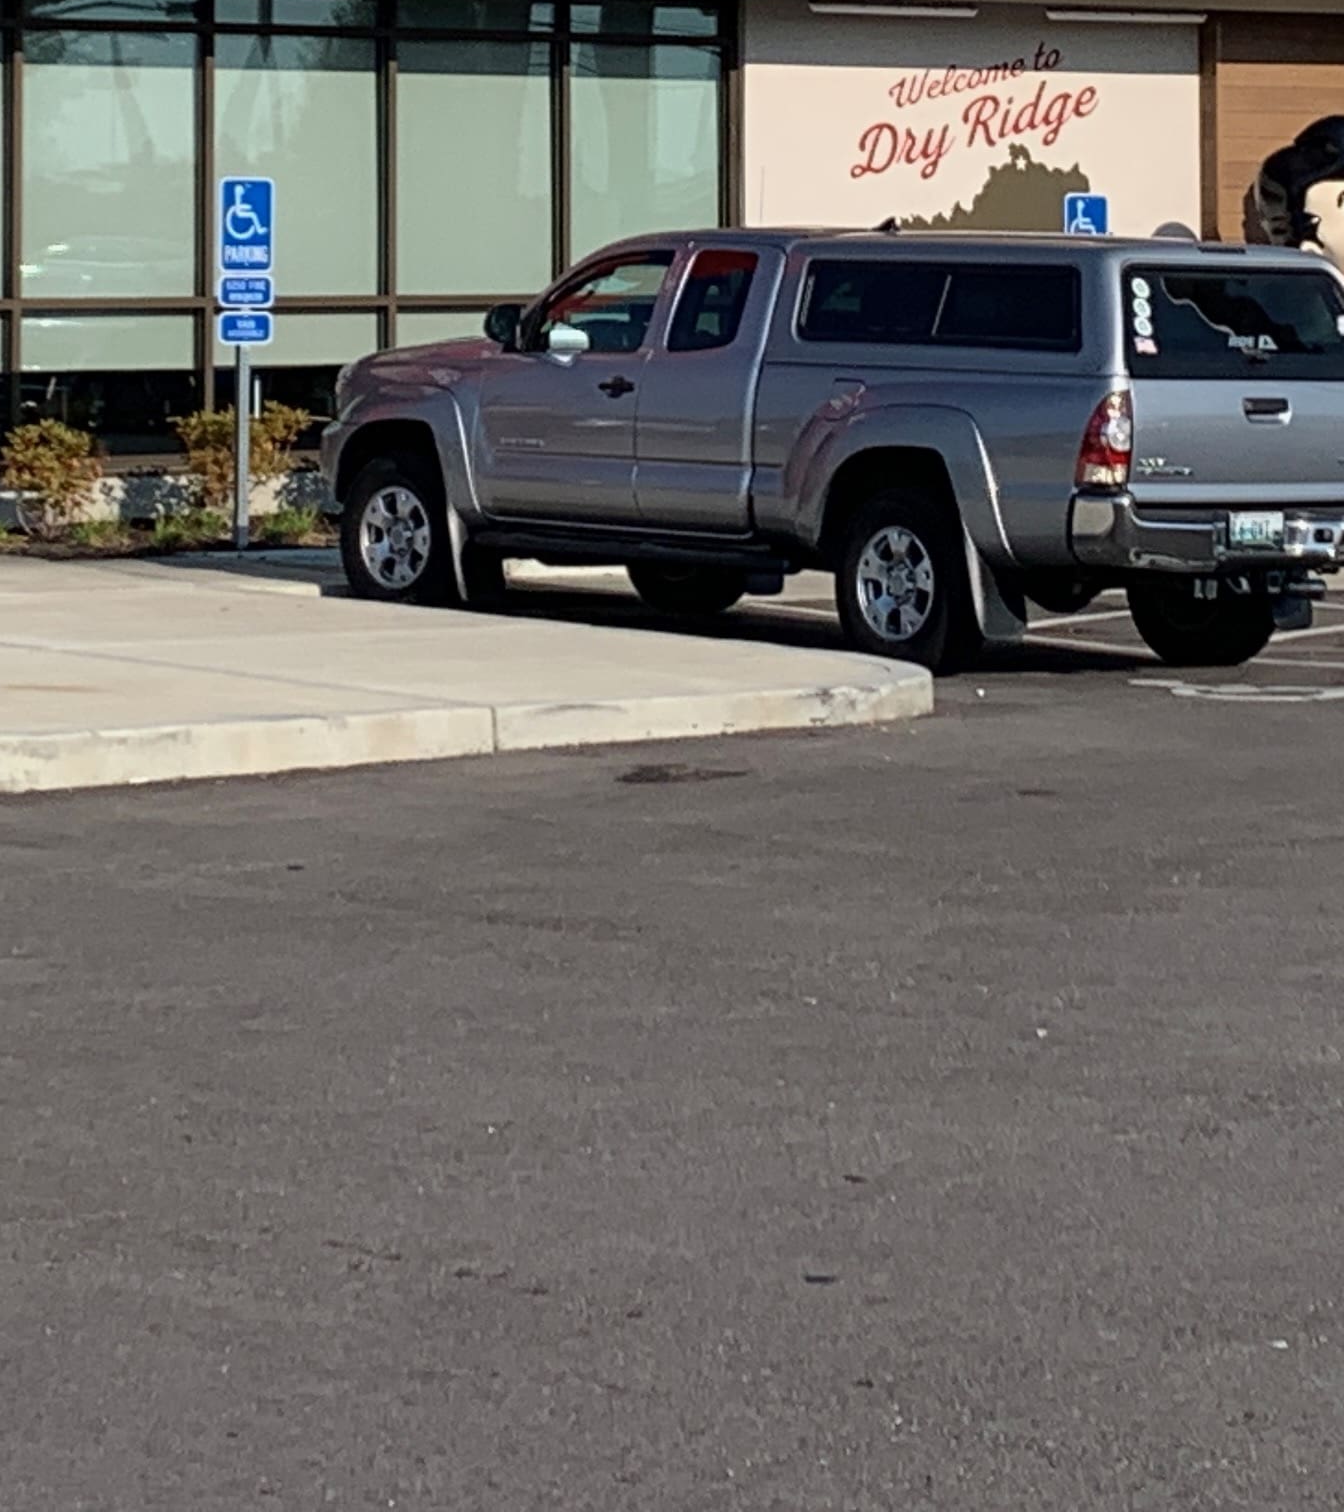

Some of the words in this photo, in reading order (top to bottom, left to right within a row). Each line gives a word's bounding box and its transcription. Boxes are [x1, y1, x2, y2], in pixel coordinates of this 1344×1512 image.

[888, 56, 1025, 109] Welcome
[1033, 41, 1063, 71] to
[849, 122, 955, 179] Dry
[962, 81, 1100, 147] Ridge
[223, 245, 269, 263] PARKING
